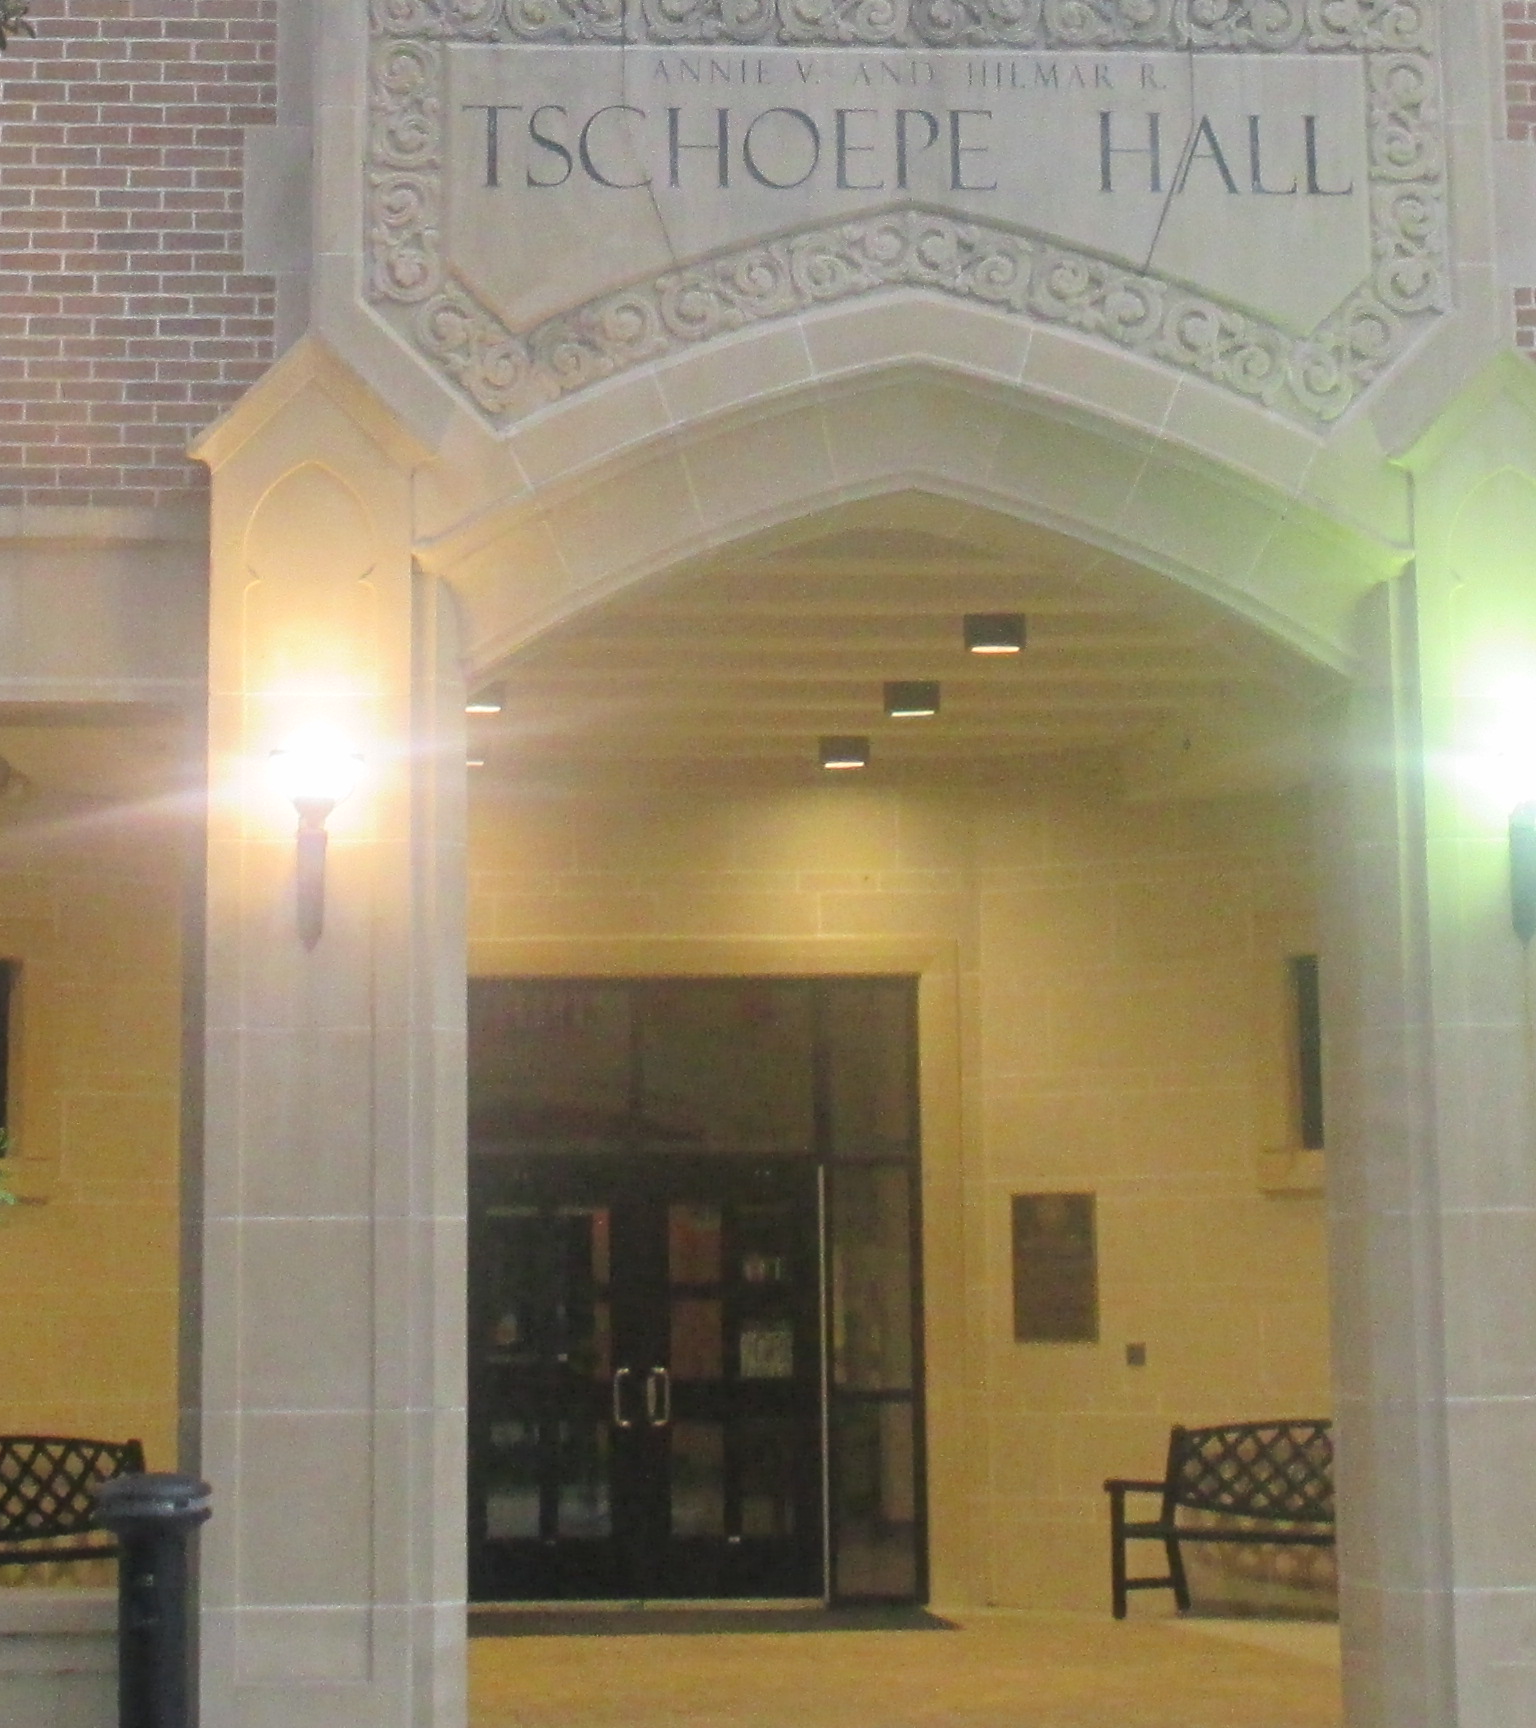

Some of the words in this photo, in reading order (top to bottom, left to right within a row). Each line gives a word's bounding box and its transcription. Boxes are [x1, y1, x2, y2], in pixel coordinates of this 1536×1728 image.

[654, 57, 774, 84] ANNIE
[796, 57, 821, 85] V.
[852, 58, 935, 87] AND
[967, 60, 1114, 89] HILMAR
[1140, 61, 1167, 89] R.
[461, 104, 1000, 192] TSCHOEPE
[1096, 109, 1355, 197] HALL
